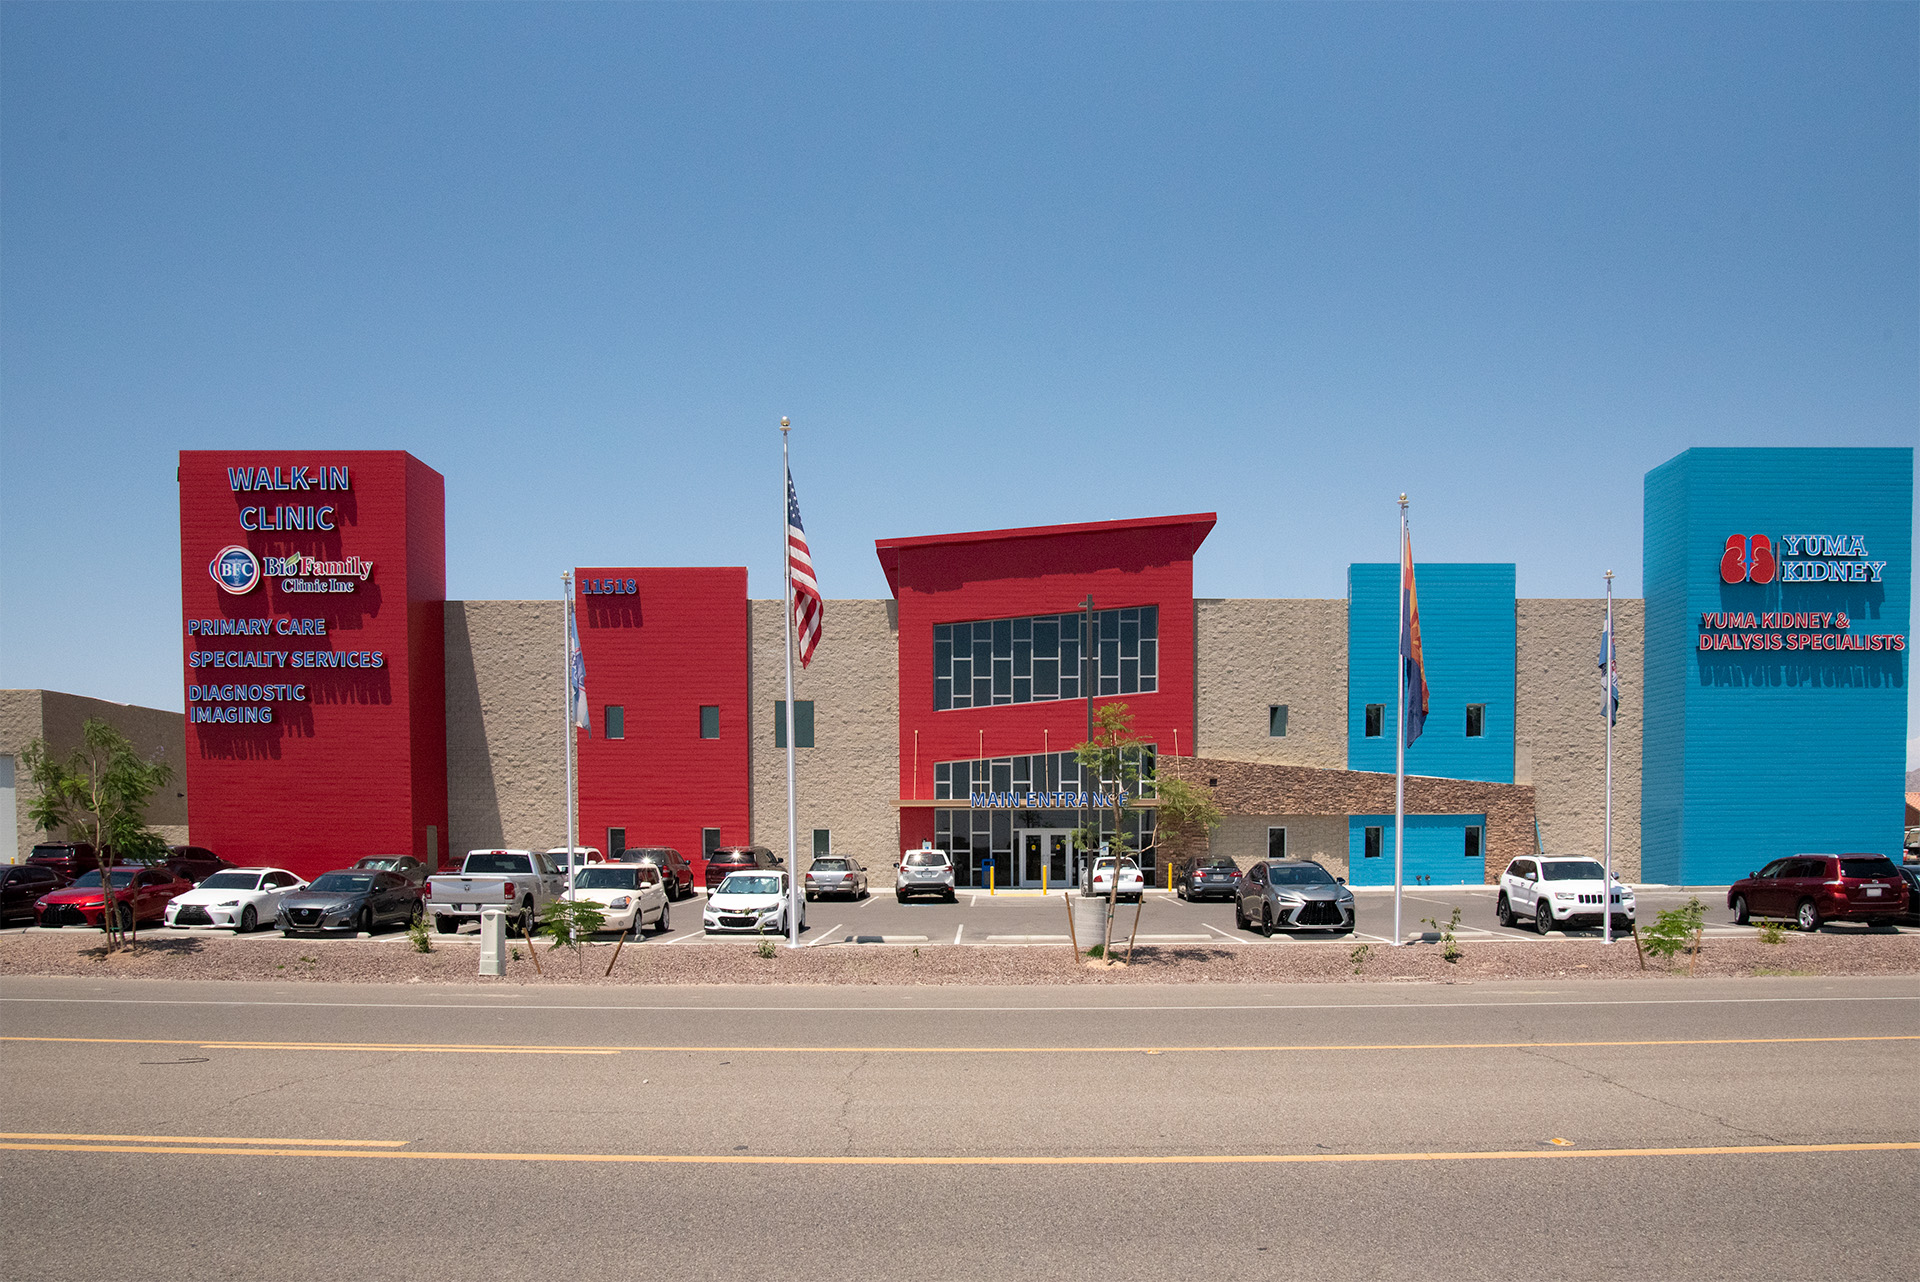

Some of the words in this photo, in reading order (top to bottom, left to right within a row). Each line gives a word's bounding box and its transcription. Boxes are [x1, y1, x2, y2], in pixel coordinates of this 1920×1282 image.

[228, 466, 349, 491] WALK-IN
[239, 506, 335, 530] CLINIC
[1782, 534, 1868, 556] YUMA
[222, 563, 254, 577] BFC
[263, 556, 298, 577] Bio
[299, 556, 373, 581] Family
[1782, 561, 1886, 583] KIDNEY
[282, 578, 328, 593] Clinic
[329, 578, 354, 592] Inc
[582, 578, 637, 594] 11518
[188, 619, 273, 636] PRIMARY
[276, 619, 326, 635] CARE
[1702, 612, 1757, 629] YUMA
[1761, 612, 1833, 629] KIDNEY
[1836, 612, 1850, 629] &
[1700, 634, 1782, 651] DIALYSIS
[1786, 634, 1905, 651] SPECIALISTS
[189, 651, 288, 668] SPECIALTY
[291, 651, 384, 668] SERVICES
[188, 684, 306, 701] DIAGNOSTIC
[190, 706, 273, 724] IMAGING
[971, 791, 1020, 808] MAIN
